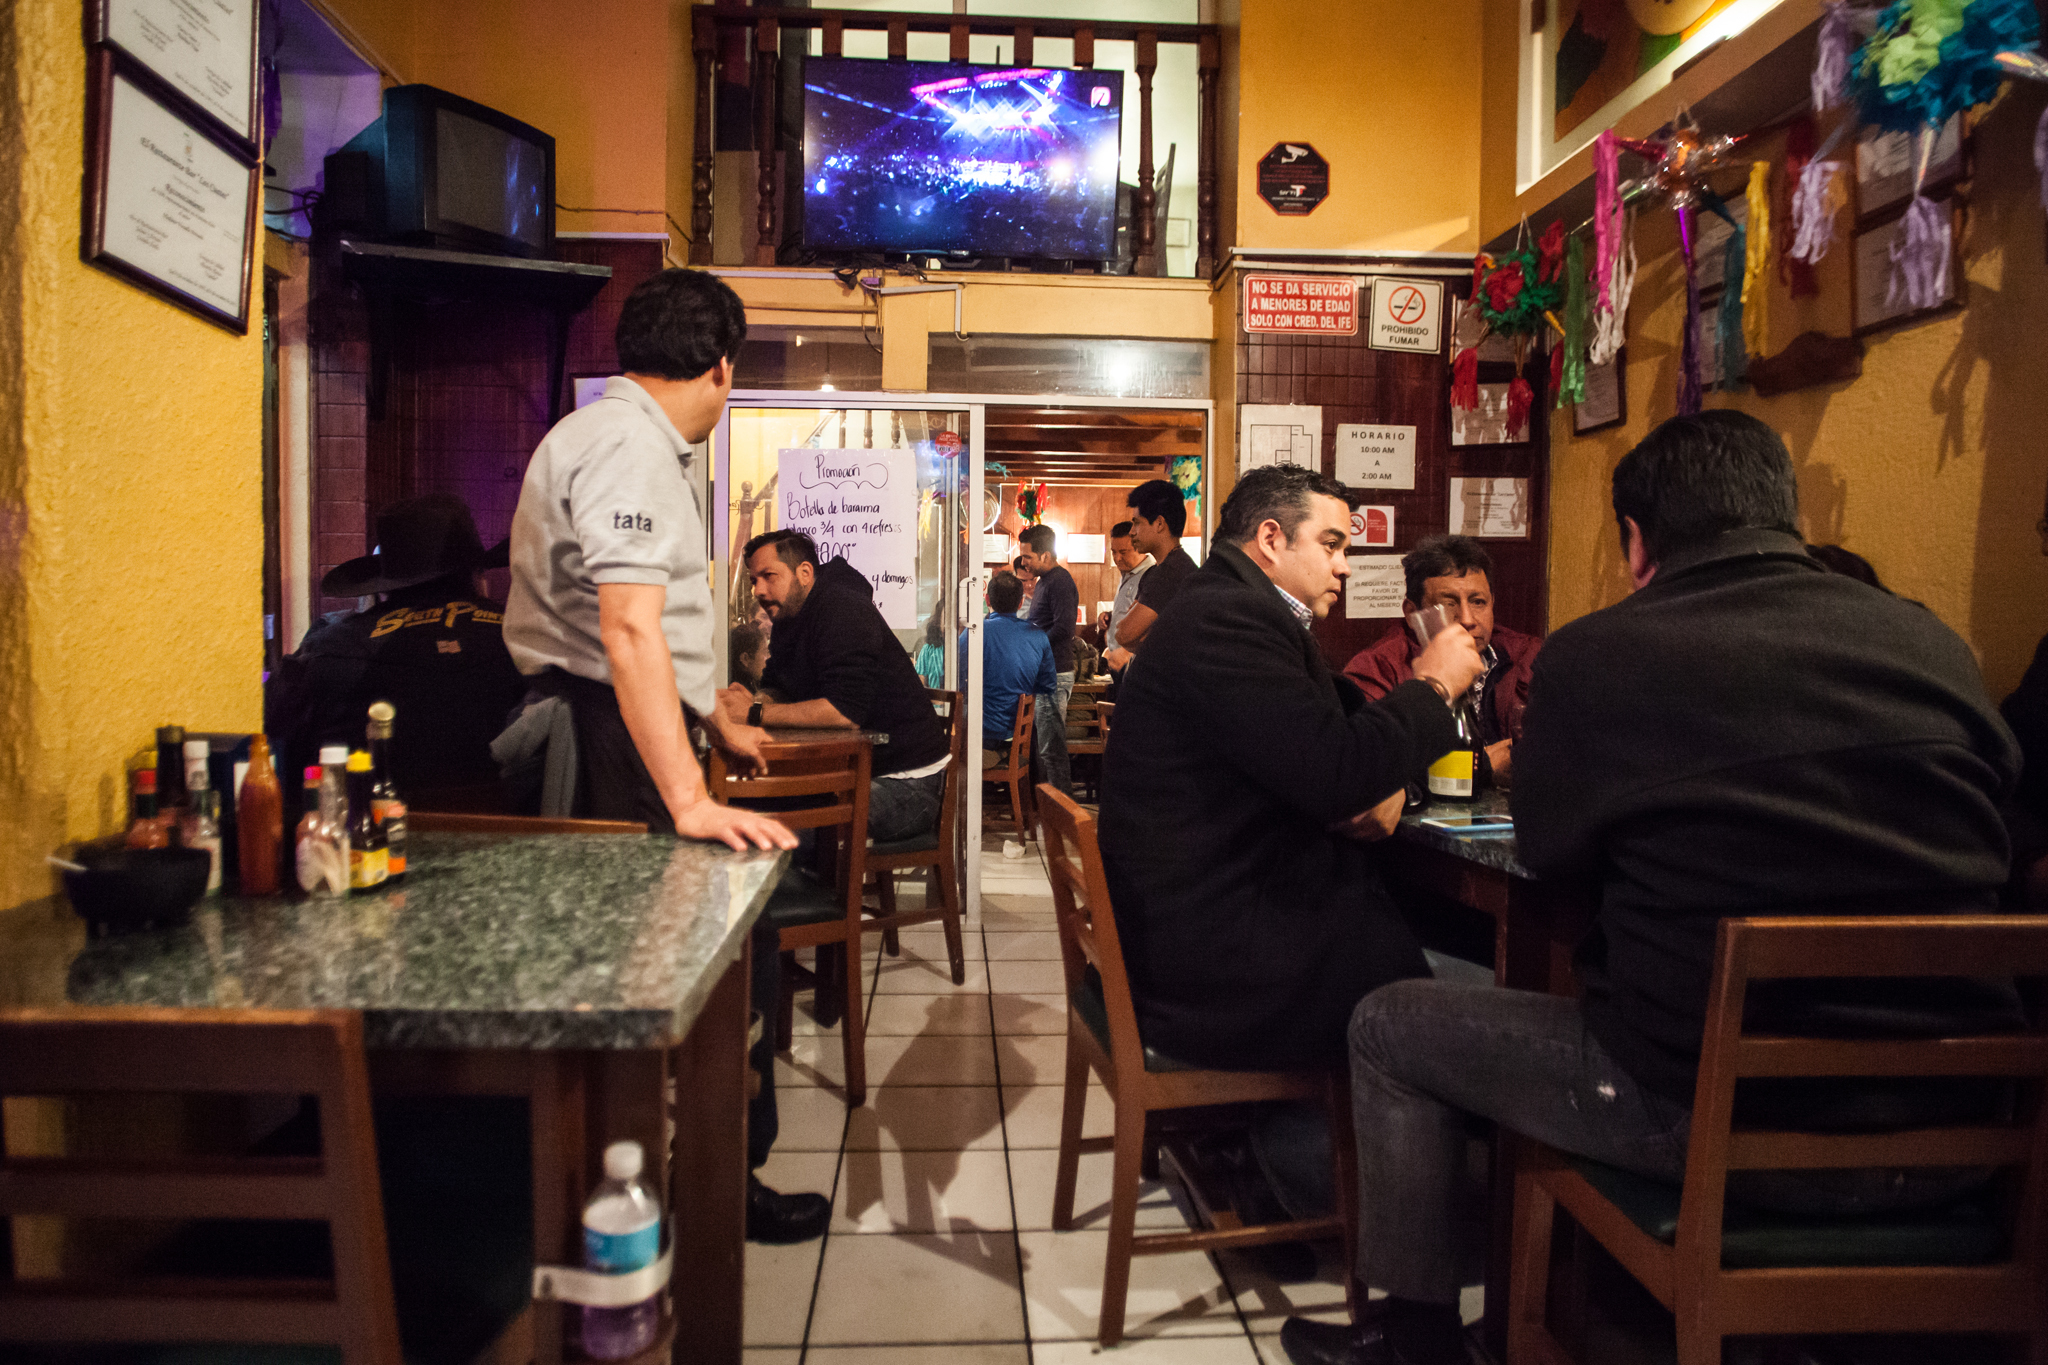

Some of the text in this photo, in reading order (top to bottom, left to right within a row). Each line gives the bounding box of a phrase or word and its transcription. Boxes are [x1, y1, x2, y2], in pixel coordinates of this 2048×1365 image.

[1252, 281, 1350, 296] NO SE DA SERVICIO
[1251, 298, 1351, 313] A MENORES DE EDAD
[1251, 314, 1351, 329] SOLO CON CRED. DEL IFE
[1381, 324, 1429, 336] PROHIBIDO
[1389, 335, 1420, 346] FUMAR
[1351, 431, 1405, 441] HORARIO
[1361, 472, 1378, 480] 2:00
[787, 491, 825, 520] Botella
[827, 500, 839, 515] de
[613, 511, 653, 533] tata
[842, 524, 858, 534] con
